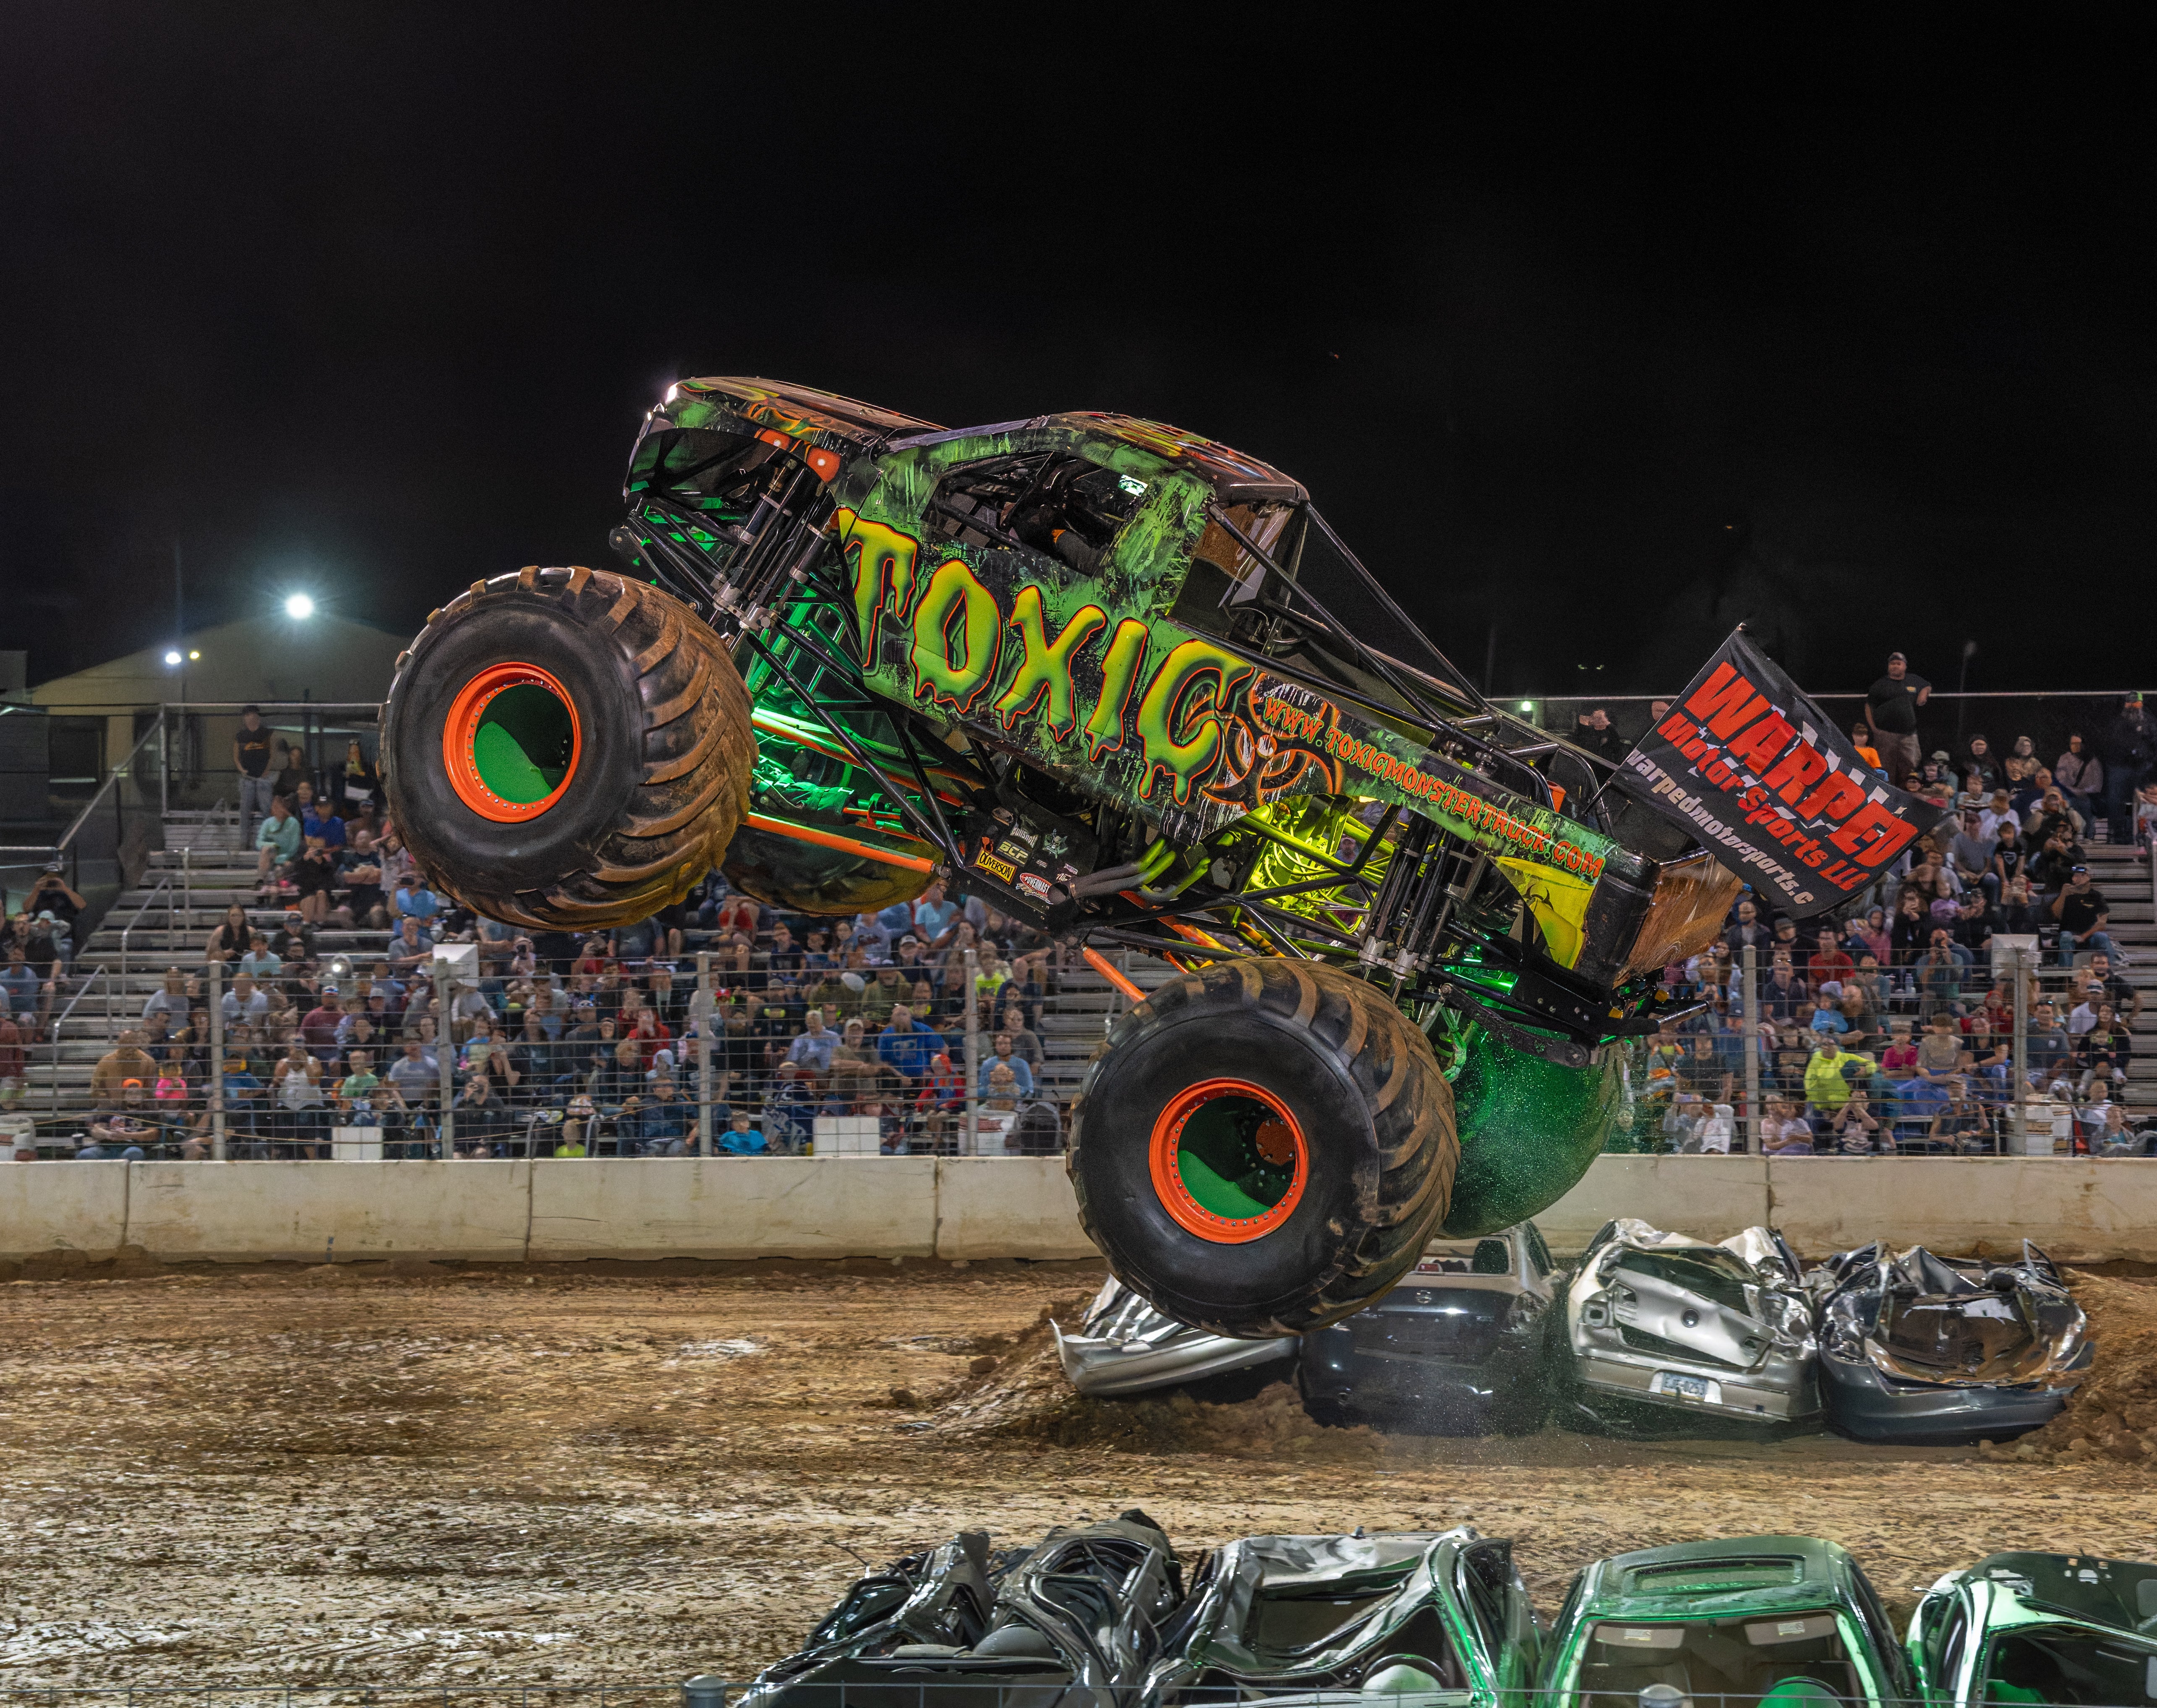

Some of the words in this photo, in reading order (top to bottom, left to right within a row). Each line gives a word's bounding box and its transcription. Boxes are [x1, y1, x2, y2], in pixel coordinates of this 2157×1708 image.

[838, 506, 1255, 806] TOXIC
[1264, 696, 1606, 879] WWW.TOXICMONSTERTRUCK.COM
[1656, 712, 1745, 792] Motor
[1684, 661, 1919, 868] WARPED
[1024, 875, 1050, 894] POWERMAST
